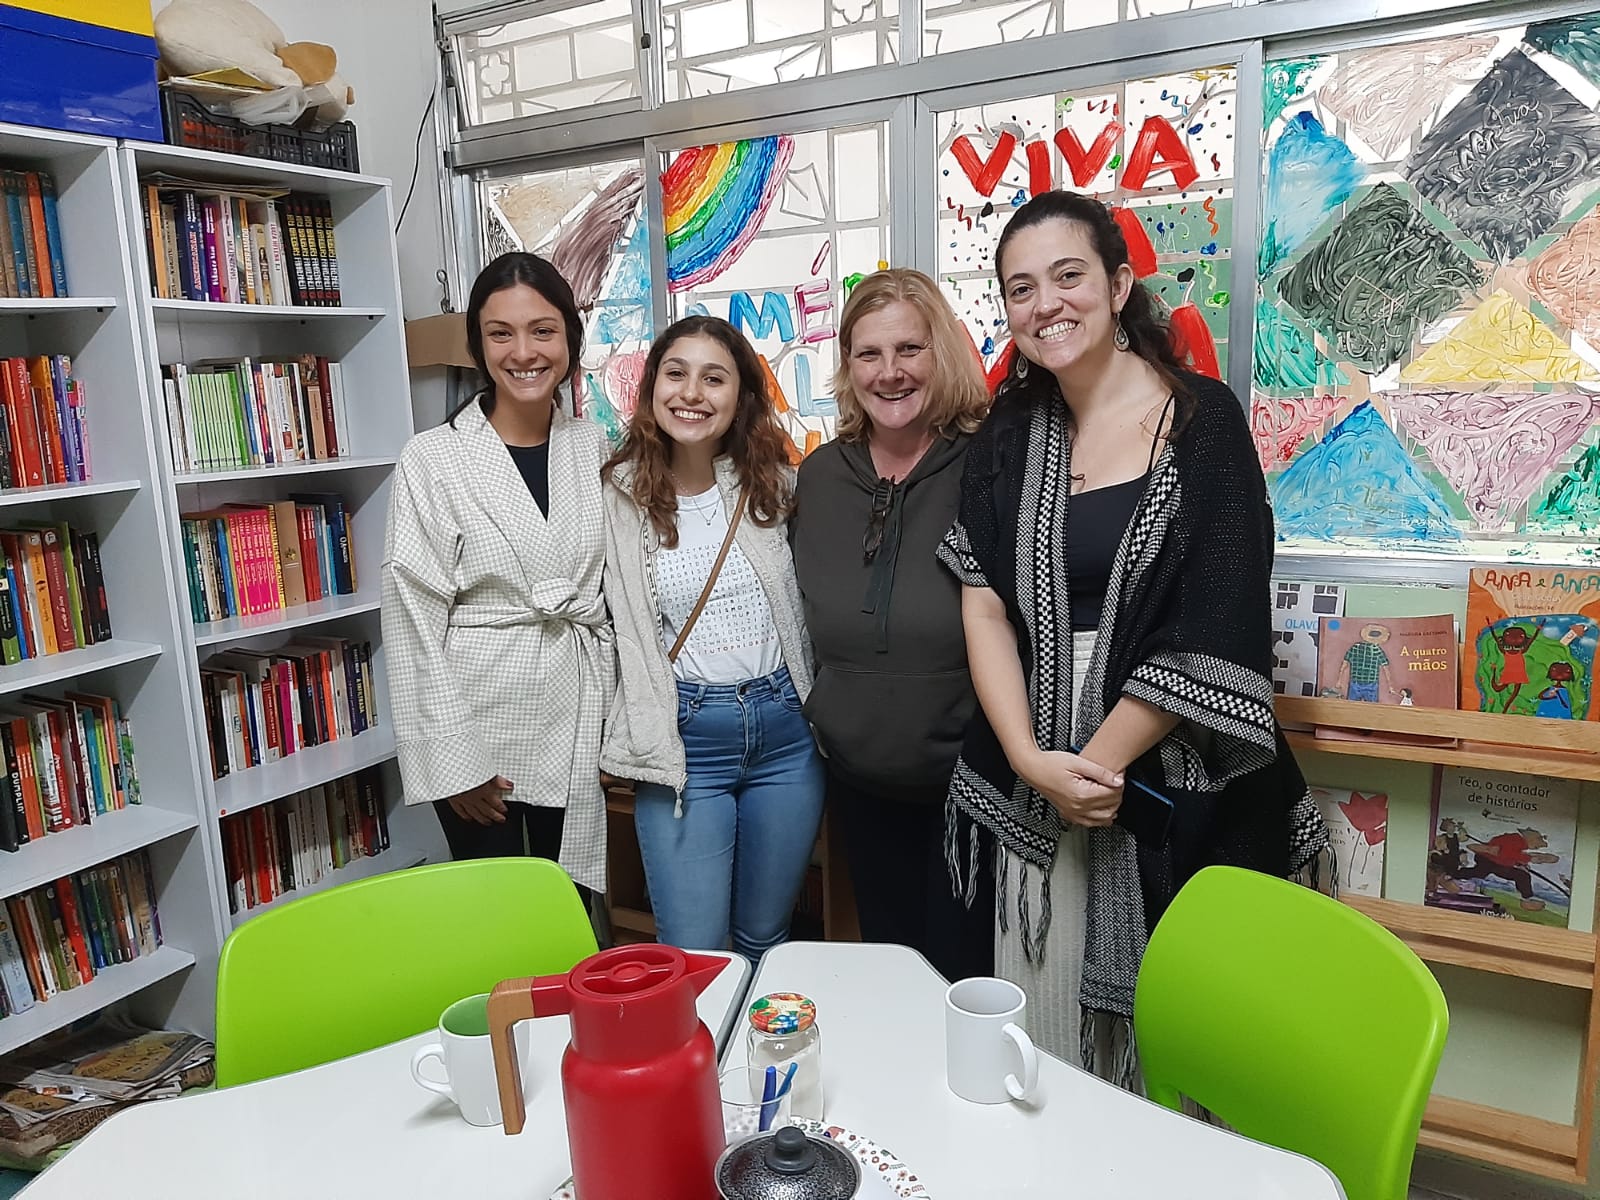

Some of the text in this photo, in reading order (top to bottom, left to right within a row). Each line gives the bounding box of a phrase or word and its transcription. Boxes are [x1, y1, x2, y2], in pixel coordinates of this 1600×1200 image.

[950, 114, 1200, 197] VIVA
[1484, 570, 1531, 591] ANA
[1551, 573, 1600, 594] ANA
[1400, 646, 1447, 657] A quatro
[1408, 658, 1447, 671] mãos
[1485, 782, 1493, 790] o
[1496, 783, 1551, 798] contador
[1468, 792, 1538, 811] de histórias
